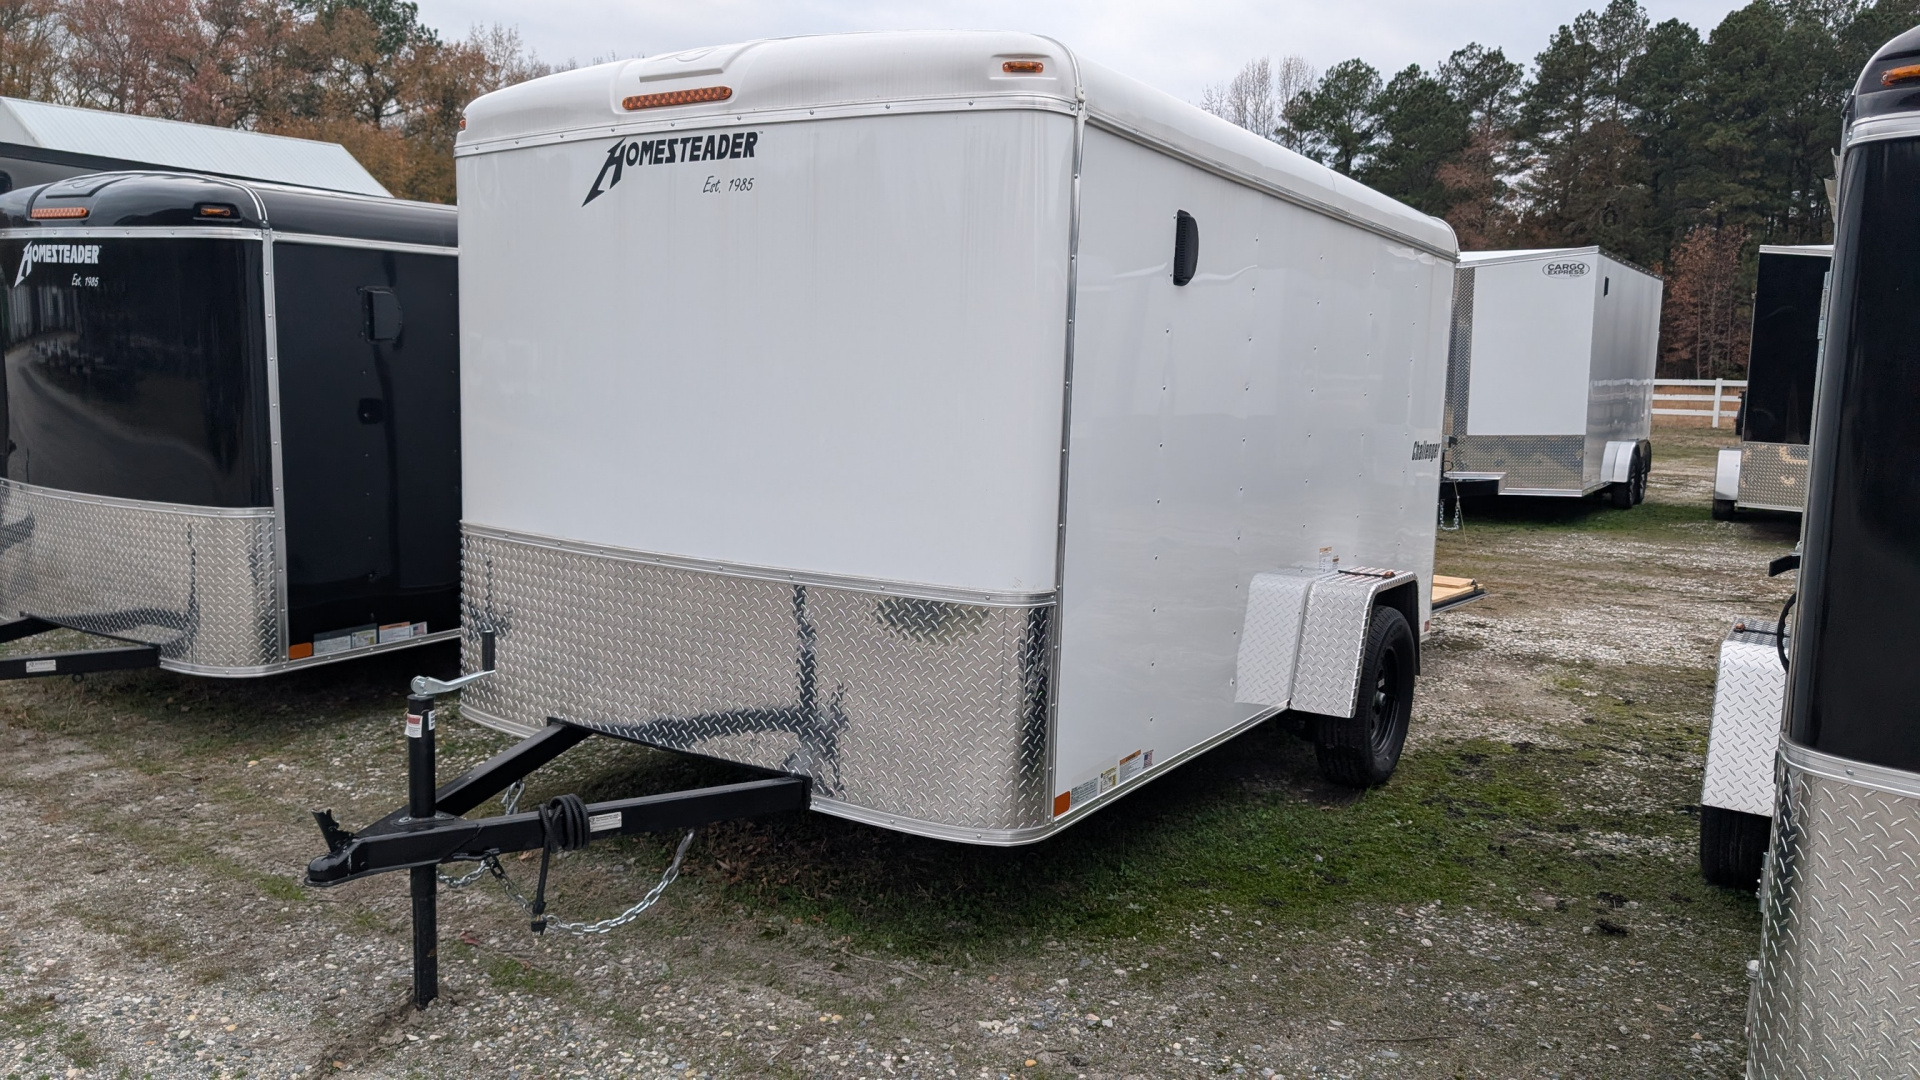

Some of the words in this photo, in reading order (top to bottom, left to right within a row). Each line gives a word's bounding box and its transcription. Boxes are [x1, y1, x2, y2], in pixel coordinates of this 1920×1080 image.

[581, 131, 758, 208] HOMESTEADER
[702, 175, 721, 194] Est.
[728, 177, 755, 192] 1985
[14, 240, 100, 288] HOMESTEADER
[1547, 263, 1585, 271] CARGO
[85, 276, 99, 288] 1985
[1411, 440, 1441, 462] Challenger
